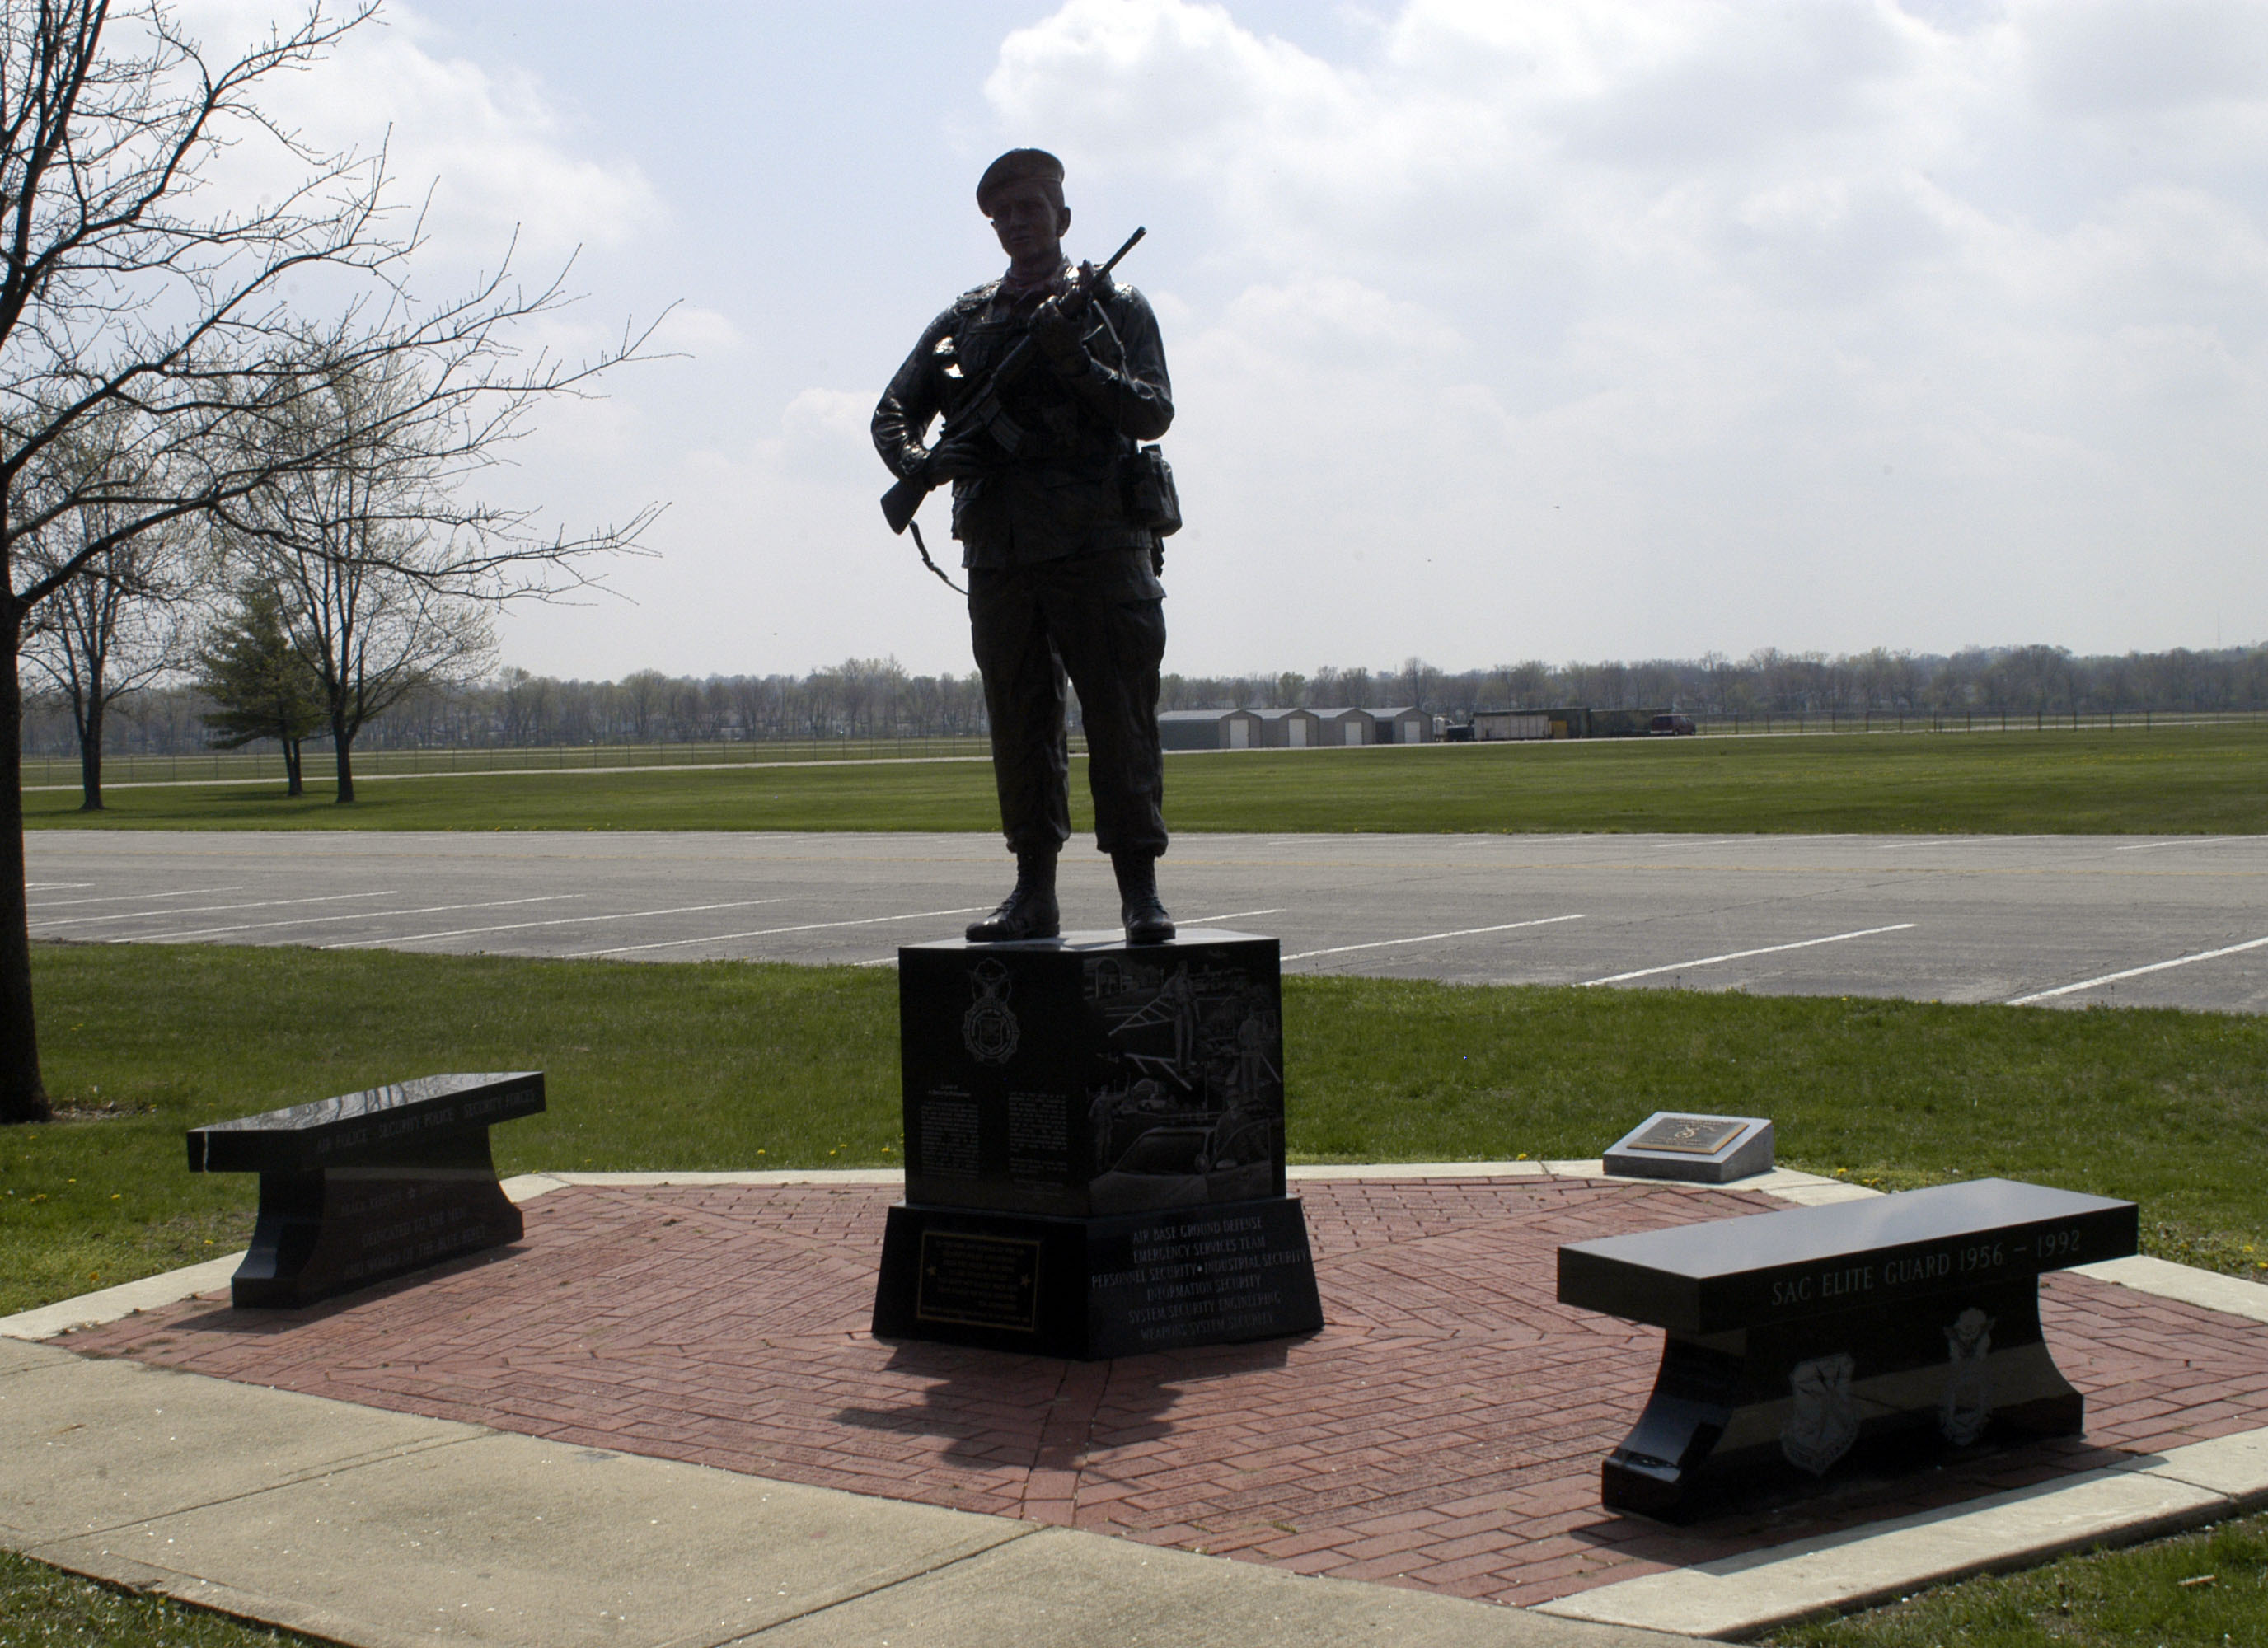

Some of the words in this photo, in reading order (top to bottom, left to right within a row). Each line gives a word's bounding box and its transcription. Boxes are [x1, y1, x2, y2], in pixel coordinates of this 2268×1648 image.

[379, 1116, 420, 1138] SECURITY
[424, 1107, 456, 1127] POLICE
[463, 1097, 502, 1117] SECURITY
[505, 1088, 535, 1108] FORCES
[1132, 1231, 1149, 1245] AIR
[1154, 1227, 1176, 1241] BASE
[1180, 1220, 1221, 1238] GROUND
[1223, 1216, 1263, 1234] DEFENSE
[1133, 1245, 1190, 1264] EMERGENCY
[1194, 1239, 1236, 1257] SERVICES
[1240, 1235, 1266, 1251] TEAM
[1091, 1272, 1147, 1289] PERSONNEL
[1149, 1263, 1197, 1281] SECURITY
[1204, 1256, 1261, 1274] INDUSTRIAL
[1262, 1250, 1308, 1267] SECURITY
[1770, 1276, 1812, 1307] SAC
[1821, 1265, 1875, 1297] ELITE
[1885, 1252, 1951, 1287] GUARD
[1958, 1242, 2004, 1272] 1956
[2037, 1229, 2081, 1259] 1992
[1147, 1281, 1212, 1302] INFORMATION
[1214, 1274, 1262, 1292] SECURITY
[1127, 1306, 1167, 1325] SYSTEM
[1169, 1299, 1215, 1318] SECURITY
[1219, 1291, 1282, 1311] ENGINEERING
[1141, 1323, 1187, 1341] WEAPONS
[1191, 1318, 1225, 1337] SYSTEM
[1229, 1311, 1273, 1330] SECURITY
